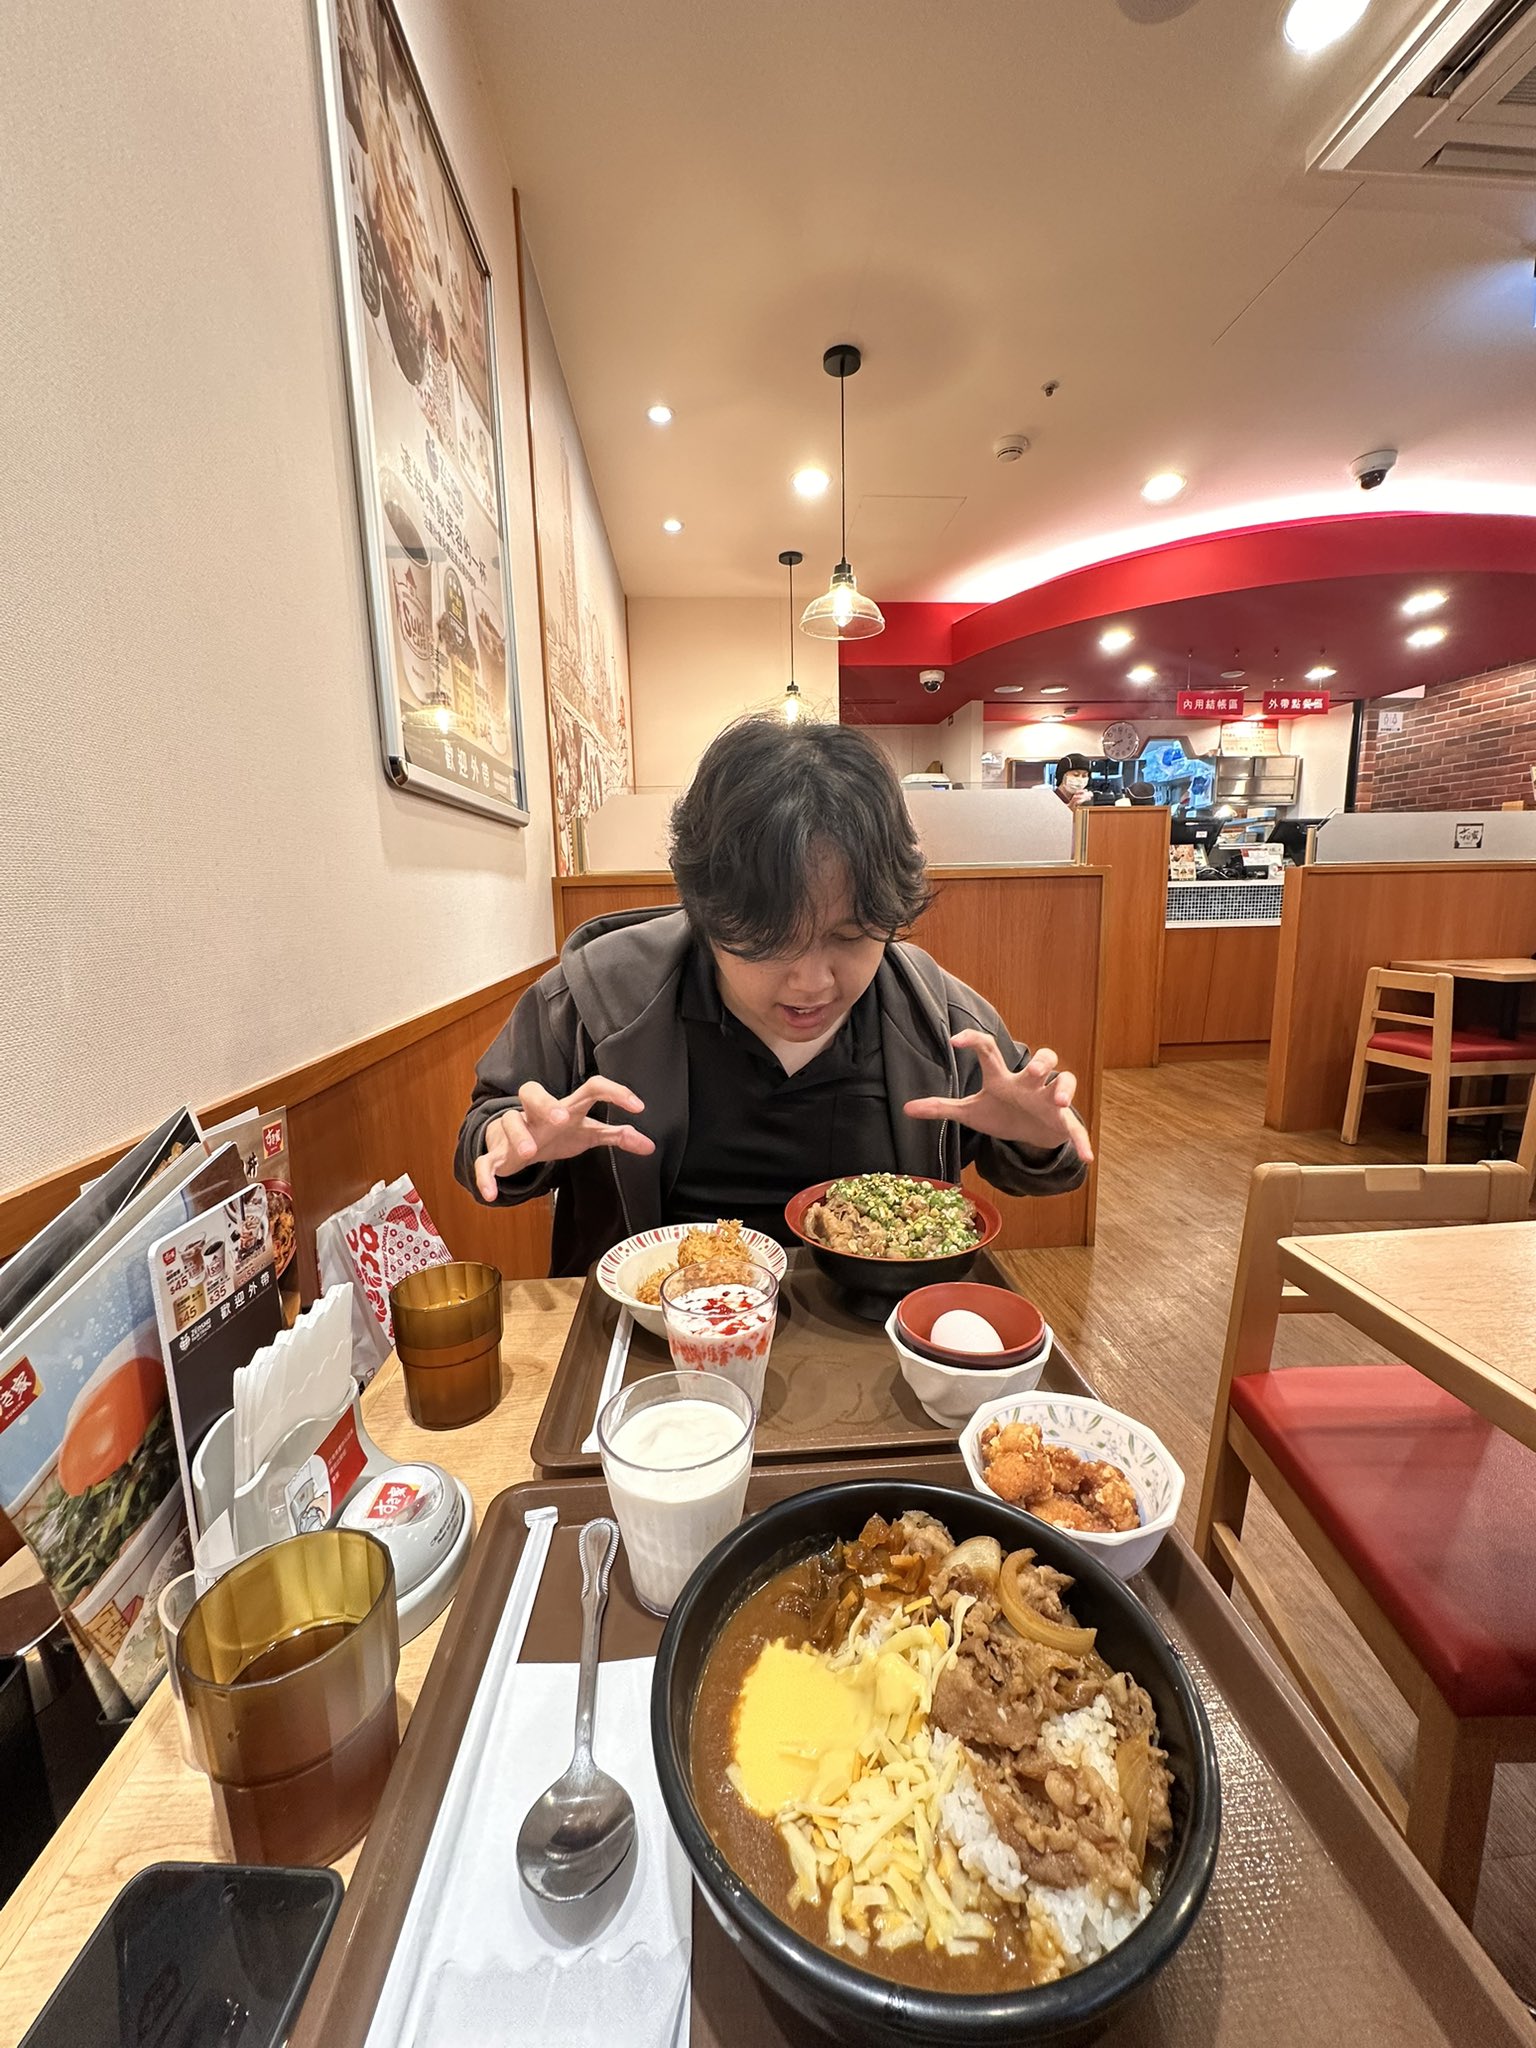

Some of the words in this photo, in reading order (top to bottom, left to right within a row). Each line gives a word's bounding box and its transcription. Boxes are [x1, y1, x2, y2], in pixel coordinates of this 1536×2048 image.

[1183, 698, 1239, 711] 內用結帳區
[170, 1275, 188, 1295] $45
[209, 1285, 227, 1305] $35
[220, 1271, 270, 1320] 歡迎外帶
[373, 1486, 407, 1516] すき家
